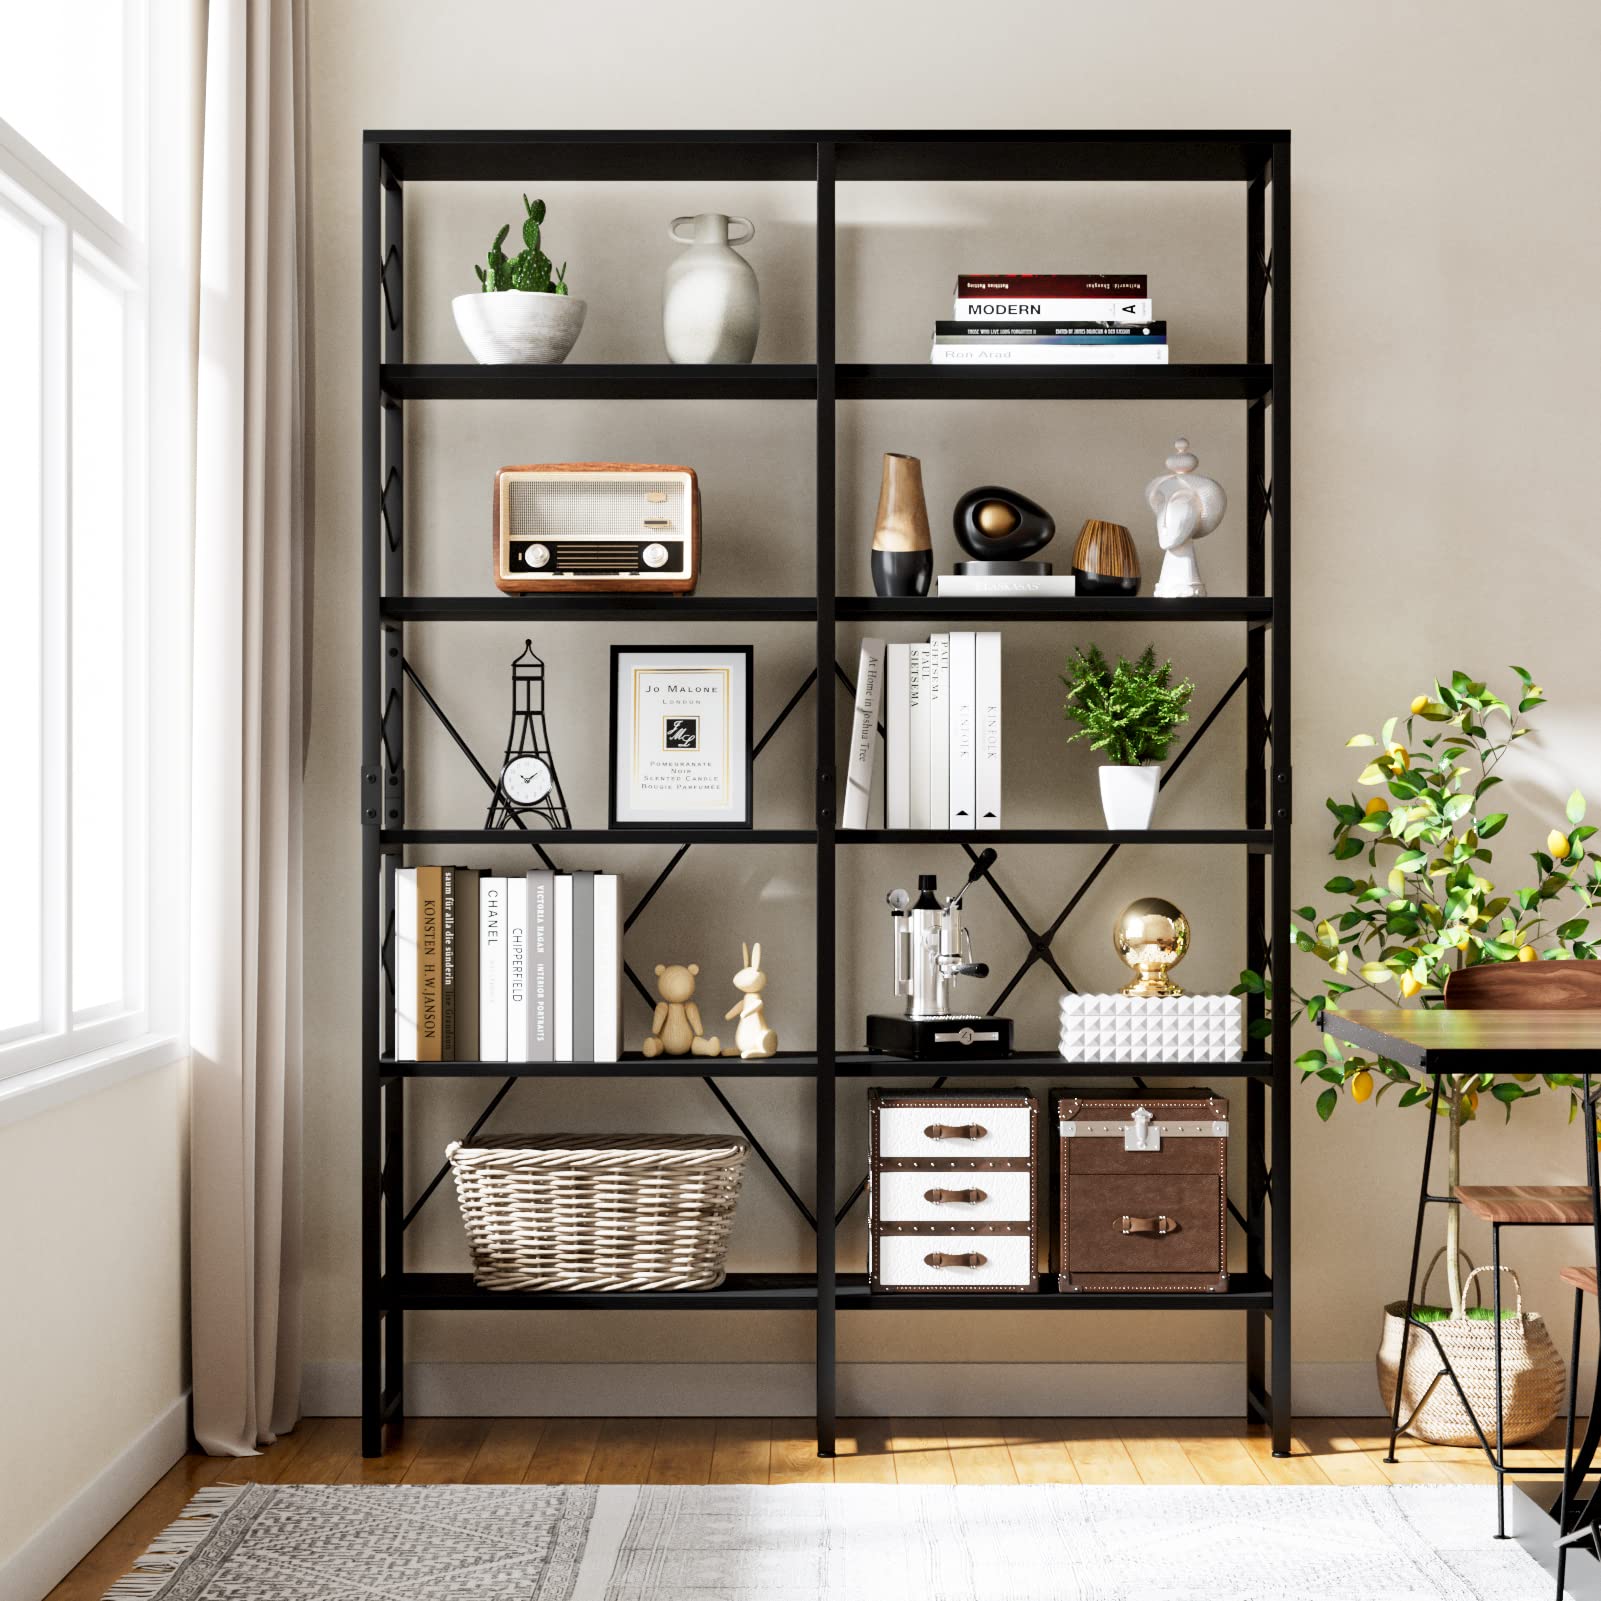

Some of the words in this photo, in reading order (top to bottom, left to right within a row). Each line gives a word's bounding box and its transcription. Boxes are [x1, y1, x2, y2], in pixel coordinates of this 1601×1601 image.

[968, 305, 1041, 315] MODERN
[1122, 304, 1136, 314] A
[945, 351, 973, 359] Ron
[978, 351, 1012, 359] Arad
[868, 656, 879, 668] At
[922, 651, 930, 680] PAUL
[865, 670, 877, 696] Home
[911, 650, 919, 708] SIETSEMA
[864, 698, 872, 708] in
[862, 708, 873, 741] Joshua
[987, 706, 997, 760] KINFOLK
[858, 743, 870, 763] Tree
[445, 898, 454, 911] für
[488, 890, 498, 946] CHANEL
[536, 885, 544, 923] VICTORIA
[424, 900, 435, 955] KONSTEN
[445, 913, 454, 930] alla
[445, 932, 454, 945] die
[536, 926, 544, 953] HAGAN
[445, 946, 454, 985] sünderin
[512, 928, 523, 1002] CHIPPERFIELD
[536, 964, 544, 999] INTERIOR
[536, 1001, 544, 1042] PORTRAITS
